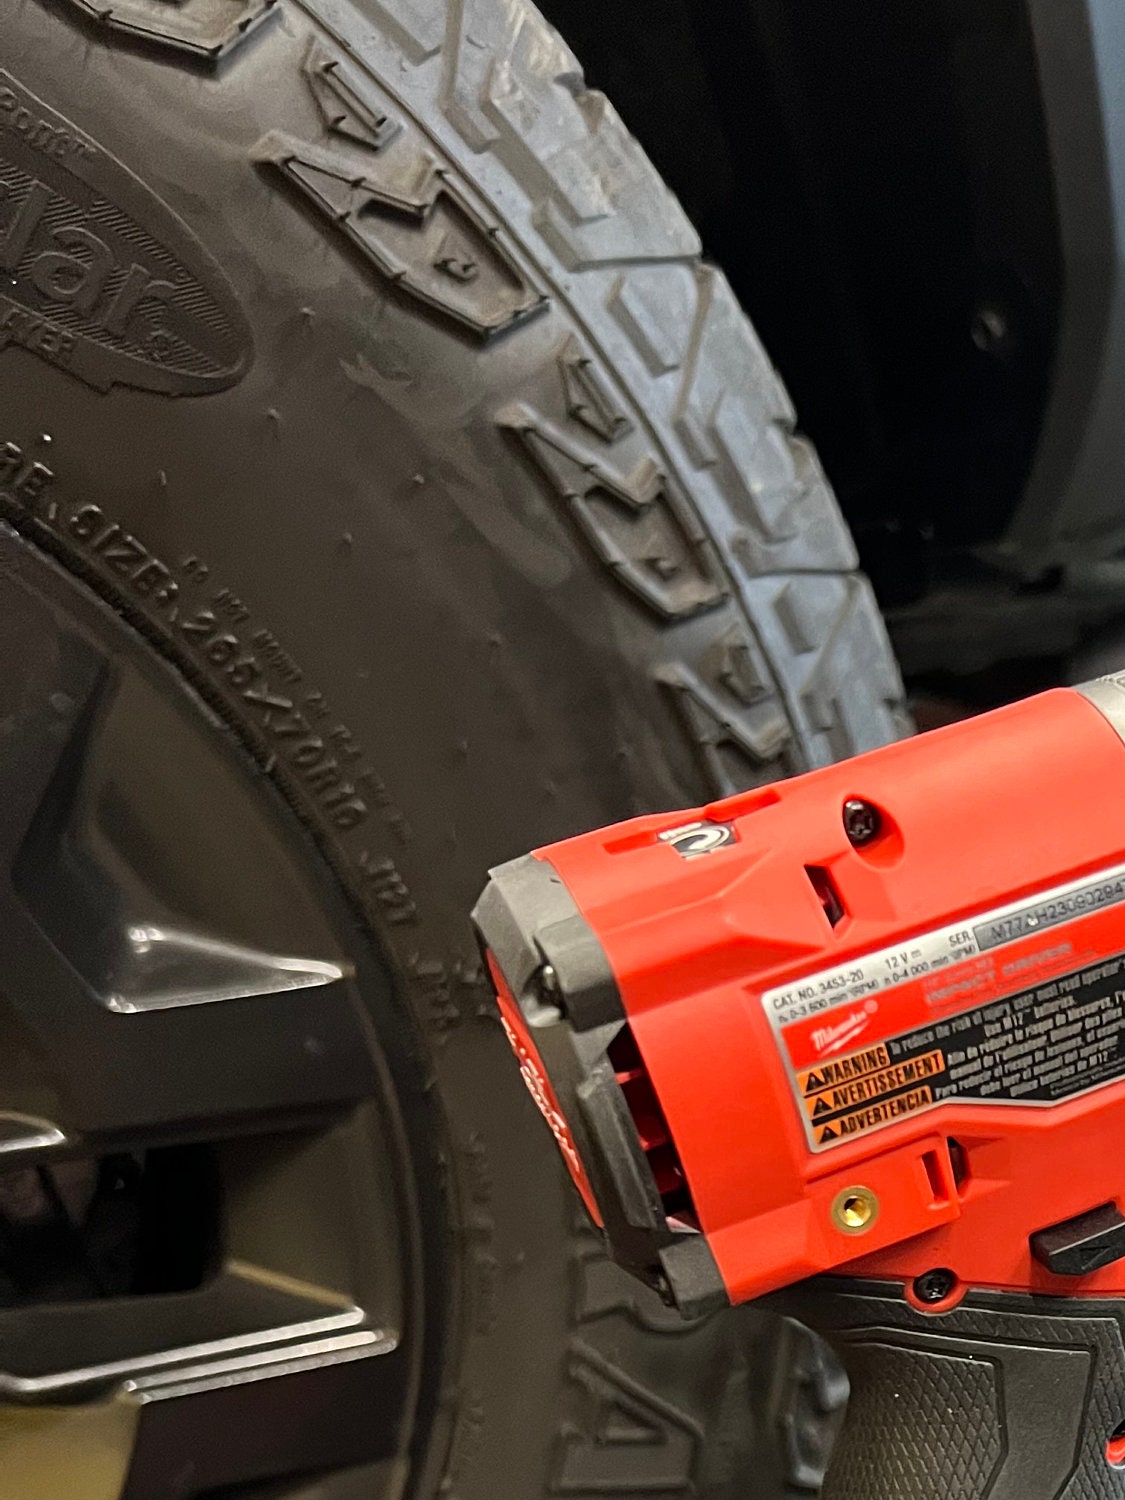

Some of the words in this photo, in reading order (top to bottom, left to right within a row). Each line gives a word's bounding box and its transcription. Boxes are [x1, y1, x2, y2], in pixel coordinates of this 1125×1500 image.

[773, 996, 794, 1010] CAT.
[798, 987, 818, 1001] NO.
[820, 968, 865, 994] 3453-20
[885, 956, 899, 969] 12
[900, 951, 910, 964] V
[948, 930, 973, 947] SER.
[821, 1045, 888, 1081] WARNING
[831, 1053, 943, 1111] AVERTISSEMENT
[838, 1088, 931, 1137] ADVERTENCIA
